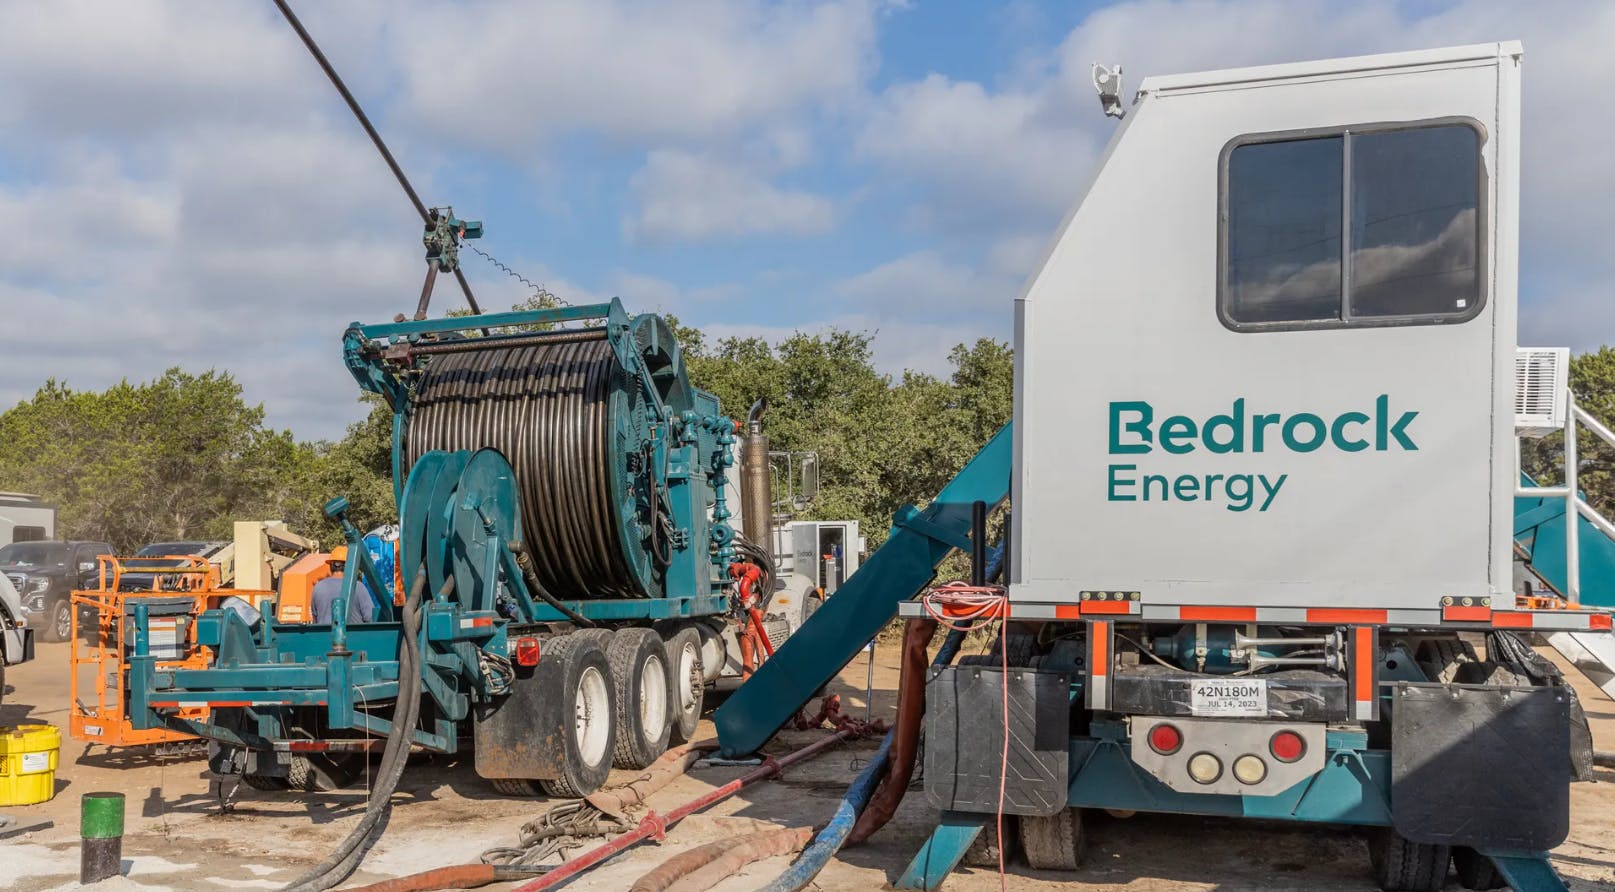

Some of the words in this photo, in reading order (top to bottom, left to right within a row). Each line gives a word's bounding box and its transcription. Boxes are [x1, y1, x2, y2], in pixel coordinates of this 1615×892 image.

[1108, 393, 1420, 455] Bedrock
[1107, 463, 1289, 512] Energy
[1197, 686, 1260, 697] 42N180M
[1207, 700, 1222, 708] JUL
[1223, 700, 1236, 709] 14,
[1237, 700, 1257, 708] 2023
